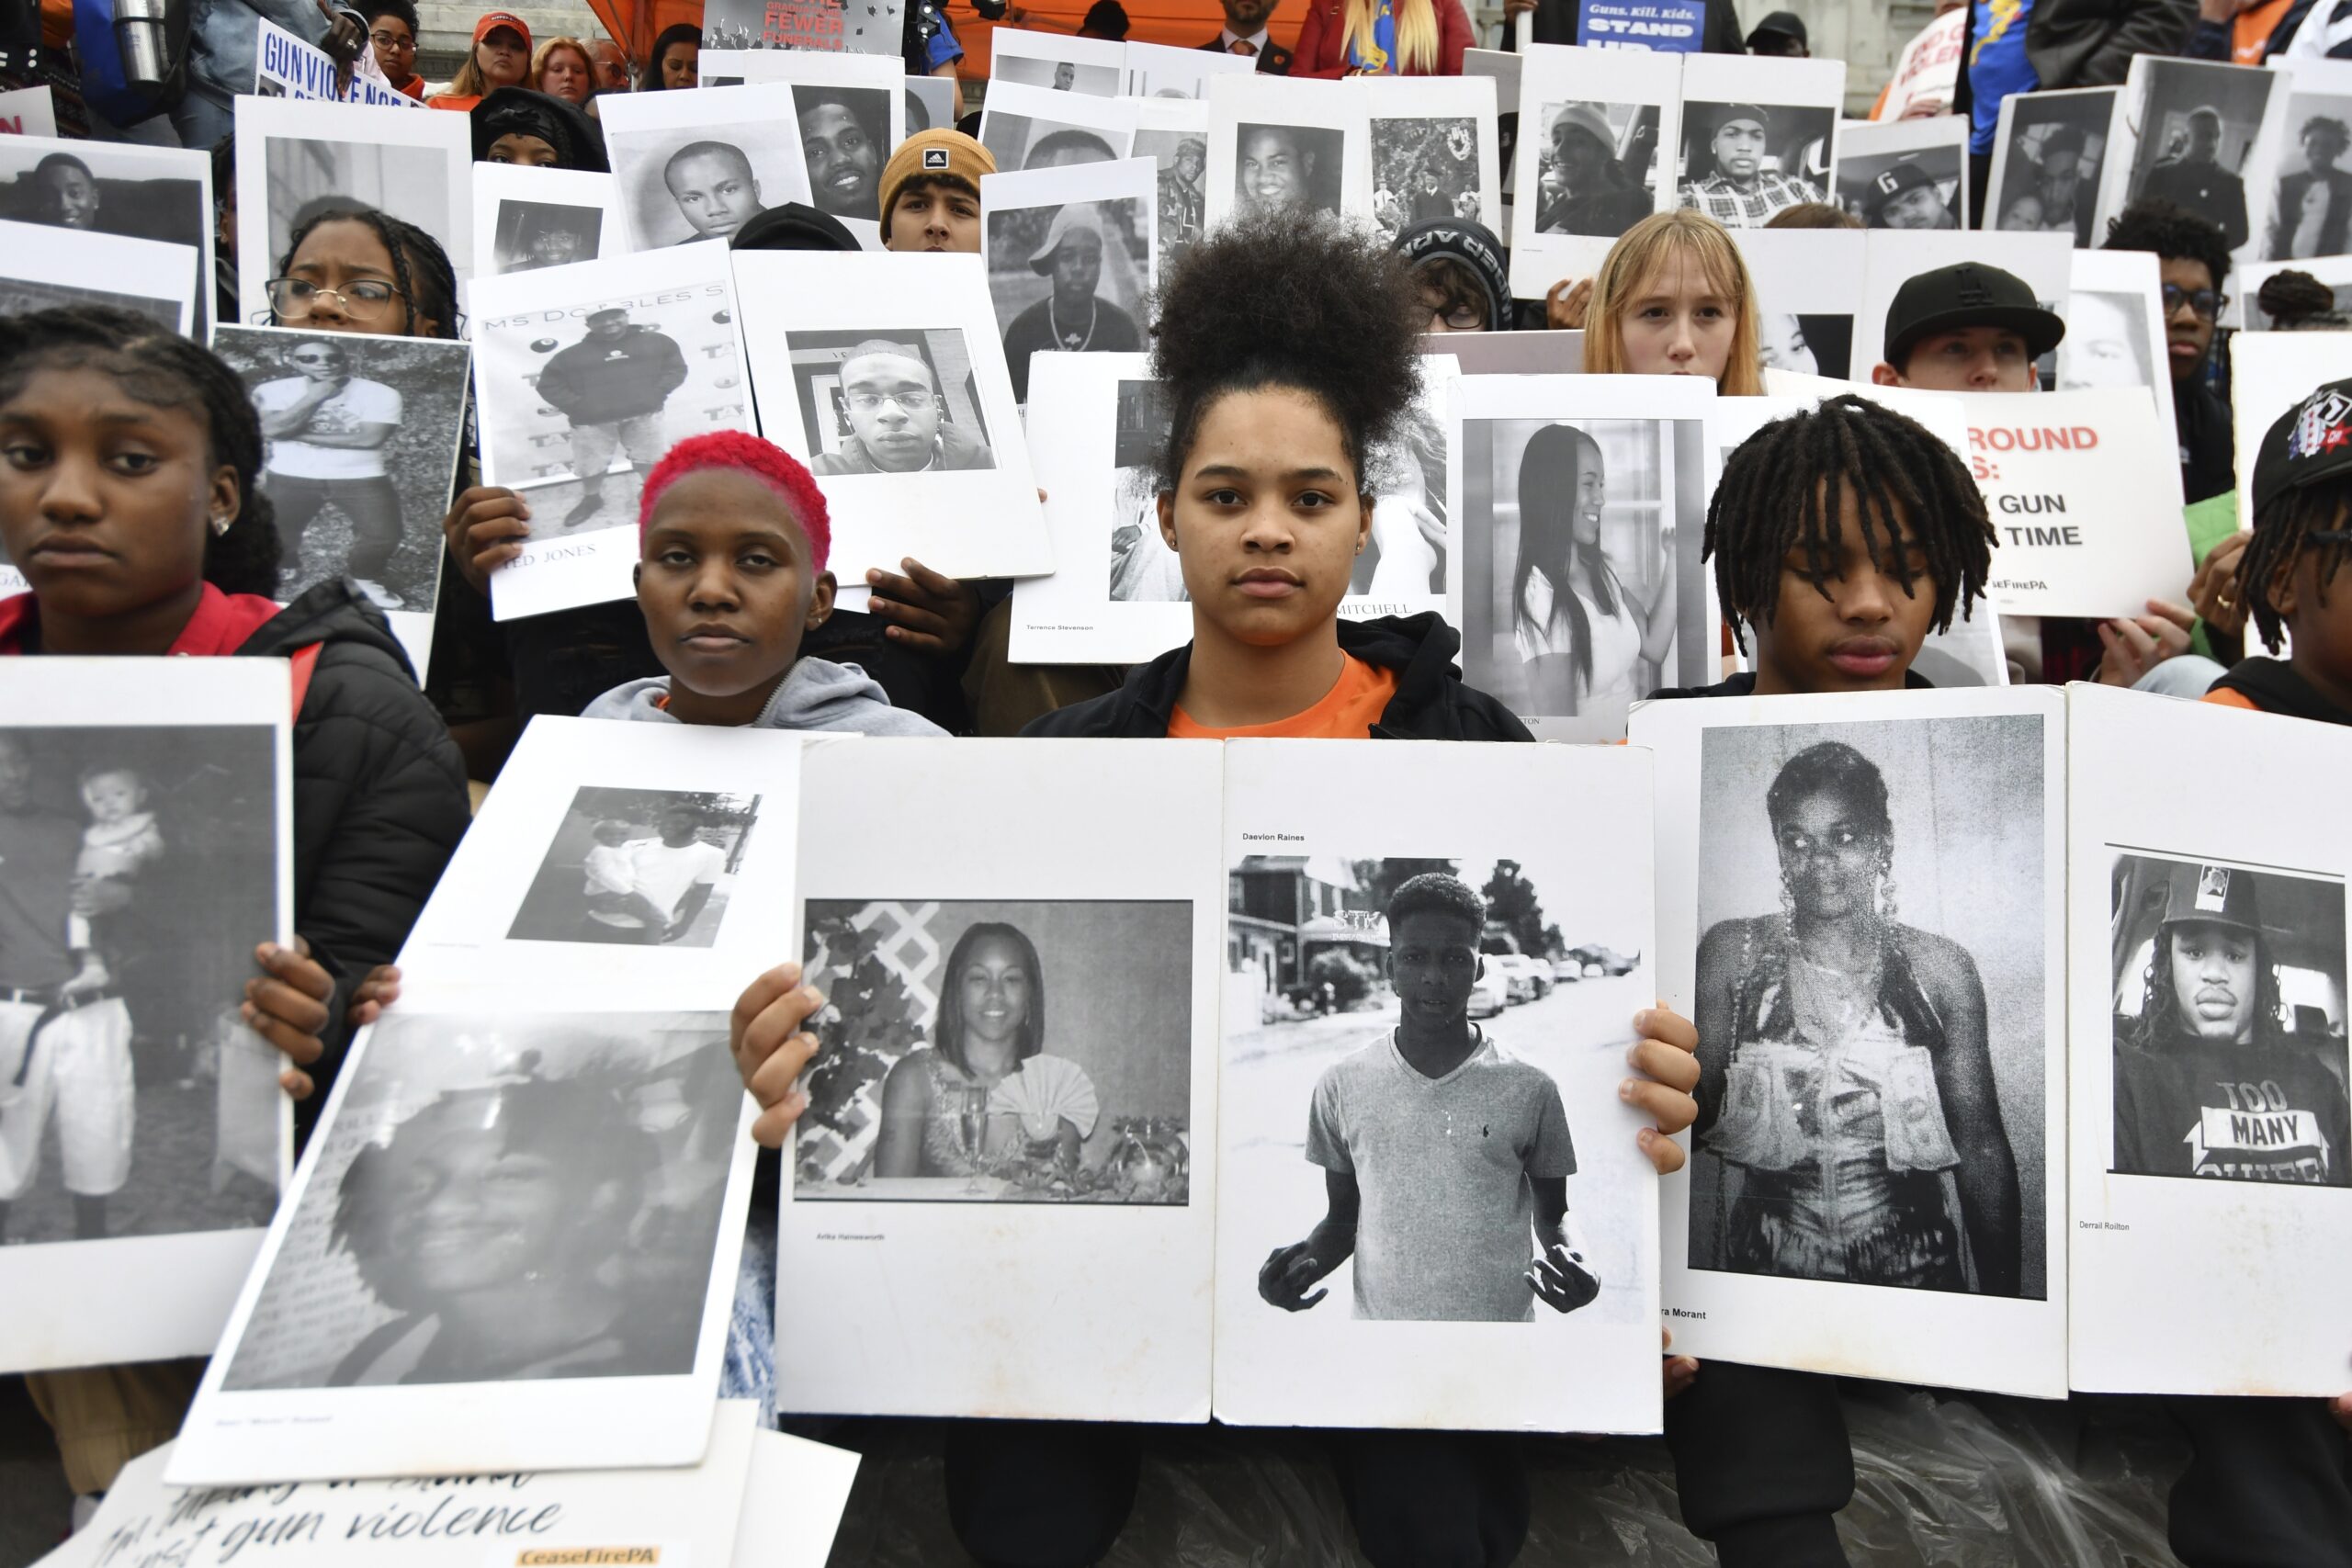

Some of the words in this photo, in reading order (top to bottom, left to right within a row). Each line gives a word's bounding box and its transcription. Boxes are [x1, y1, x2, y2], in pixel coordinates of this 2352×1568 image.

[1589, 4, 1628, 17] Guns.
[1630, 6, 1658, 18] Kill.
[1661, 8, 1696, 20] Kids.
[763, 10, 844, 36] FEWER
[1588, 18, 1694, 38] STAND
[763, 30, 844, 51] FUNERALS
[265, 32, 303, 85] GUN
[305, 51, 401, 107] VIOEN
[485, 316, 529, 331] MS
[1998, 494, 2066, 514] GUN
[2004, 525, 2083, 547] TIME
[544, 543, 596, 563] JONES
[1337, 604, 1412, 615] MITCHELL
[1277, 833, 1305, 841] Raines
[2215, 1079, 2288, 1112] TOO
[2231, 1114, 2297, 1145] MANY
[1672, 1307, 1706, 1319] Morant
[217, 1511, 325, 1564] gun
[345, 1493, 563, 1540] violence
[520, 1548, 656, 1565] CeaseFirePA
